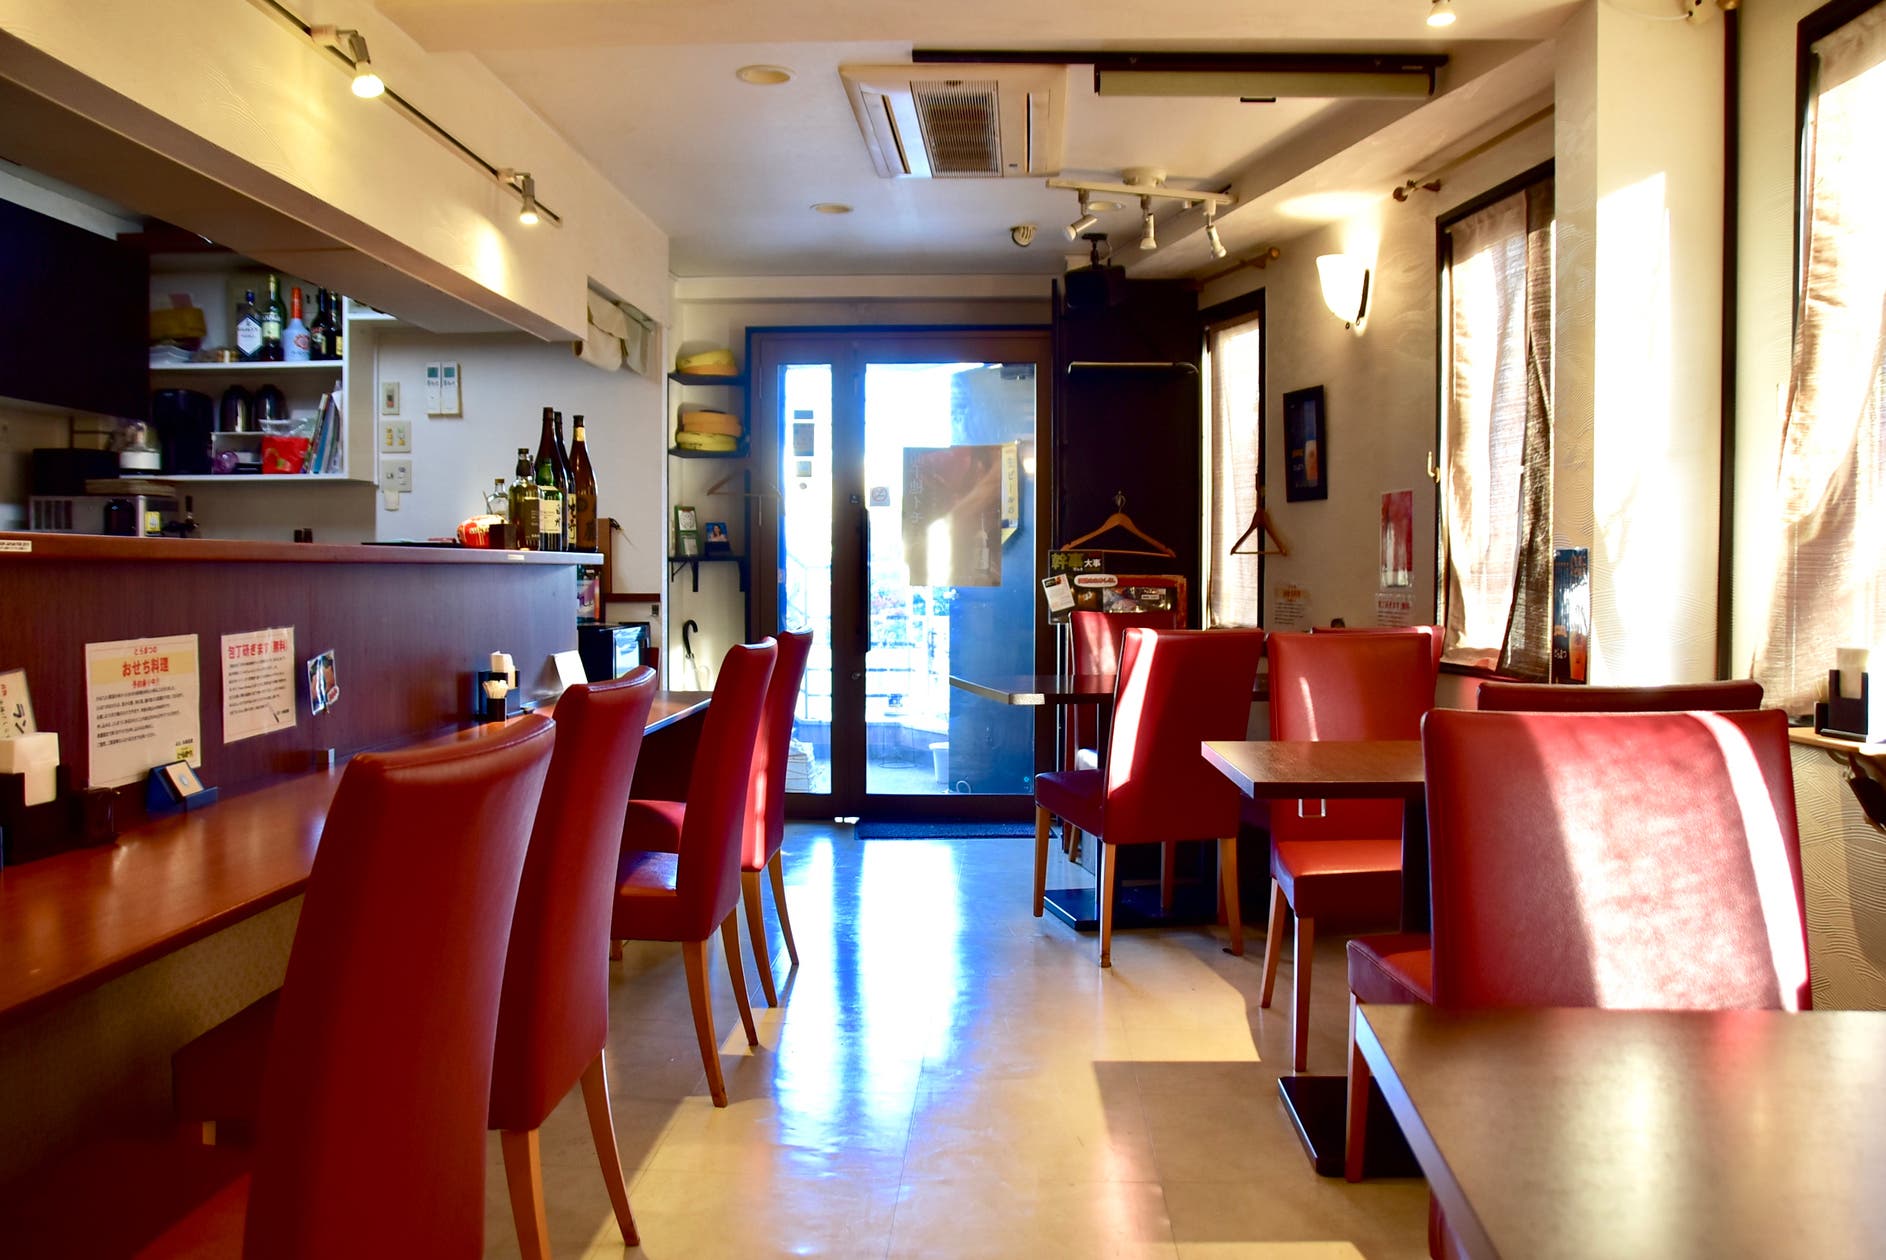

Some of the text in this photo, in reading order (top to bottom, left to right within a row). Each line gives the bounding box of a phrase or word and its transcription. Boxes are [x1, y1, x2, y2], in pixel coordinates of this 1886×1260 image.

[228, 642, 269, 660] 包丁研ぎます
[123, 657, 169, 677] おせち料理
